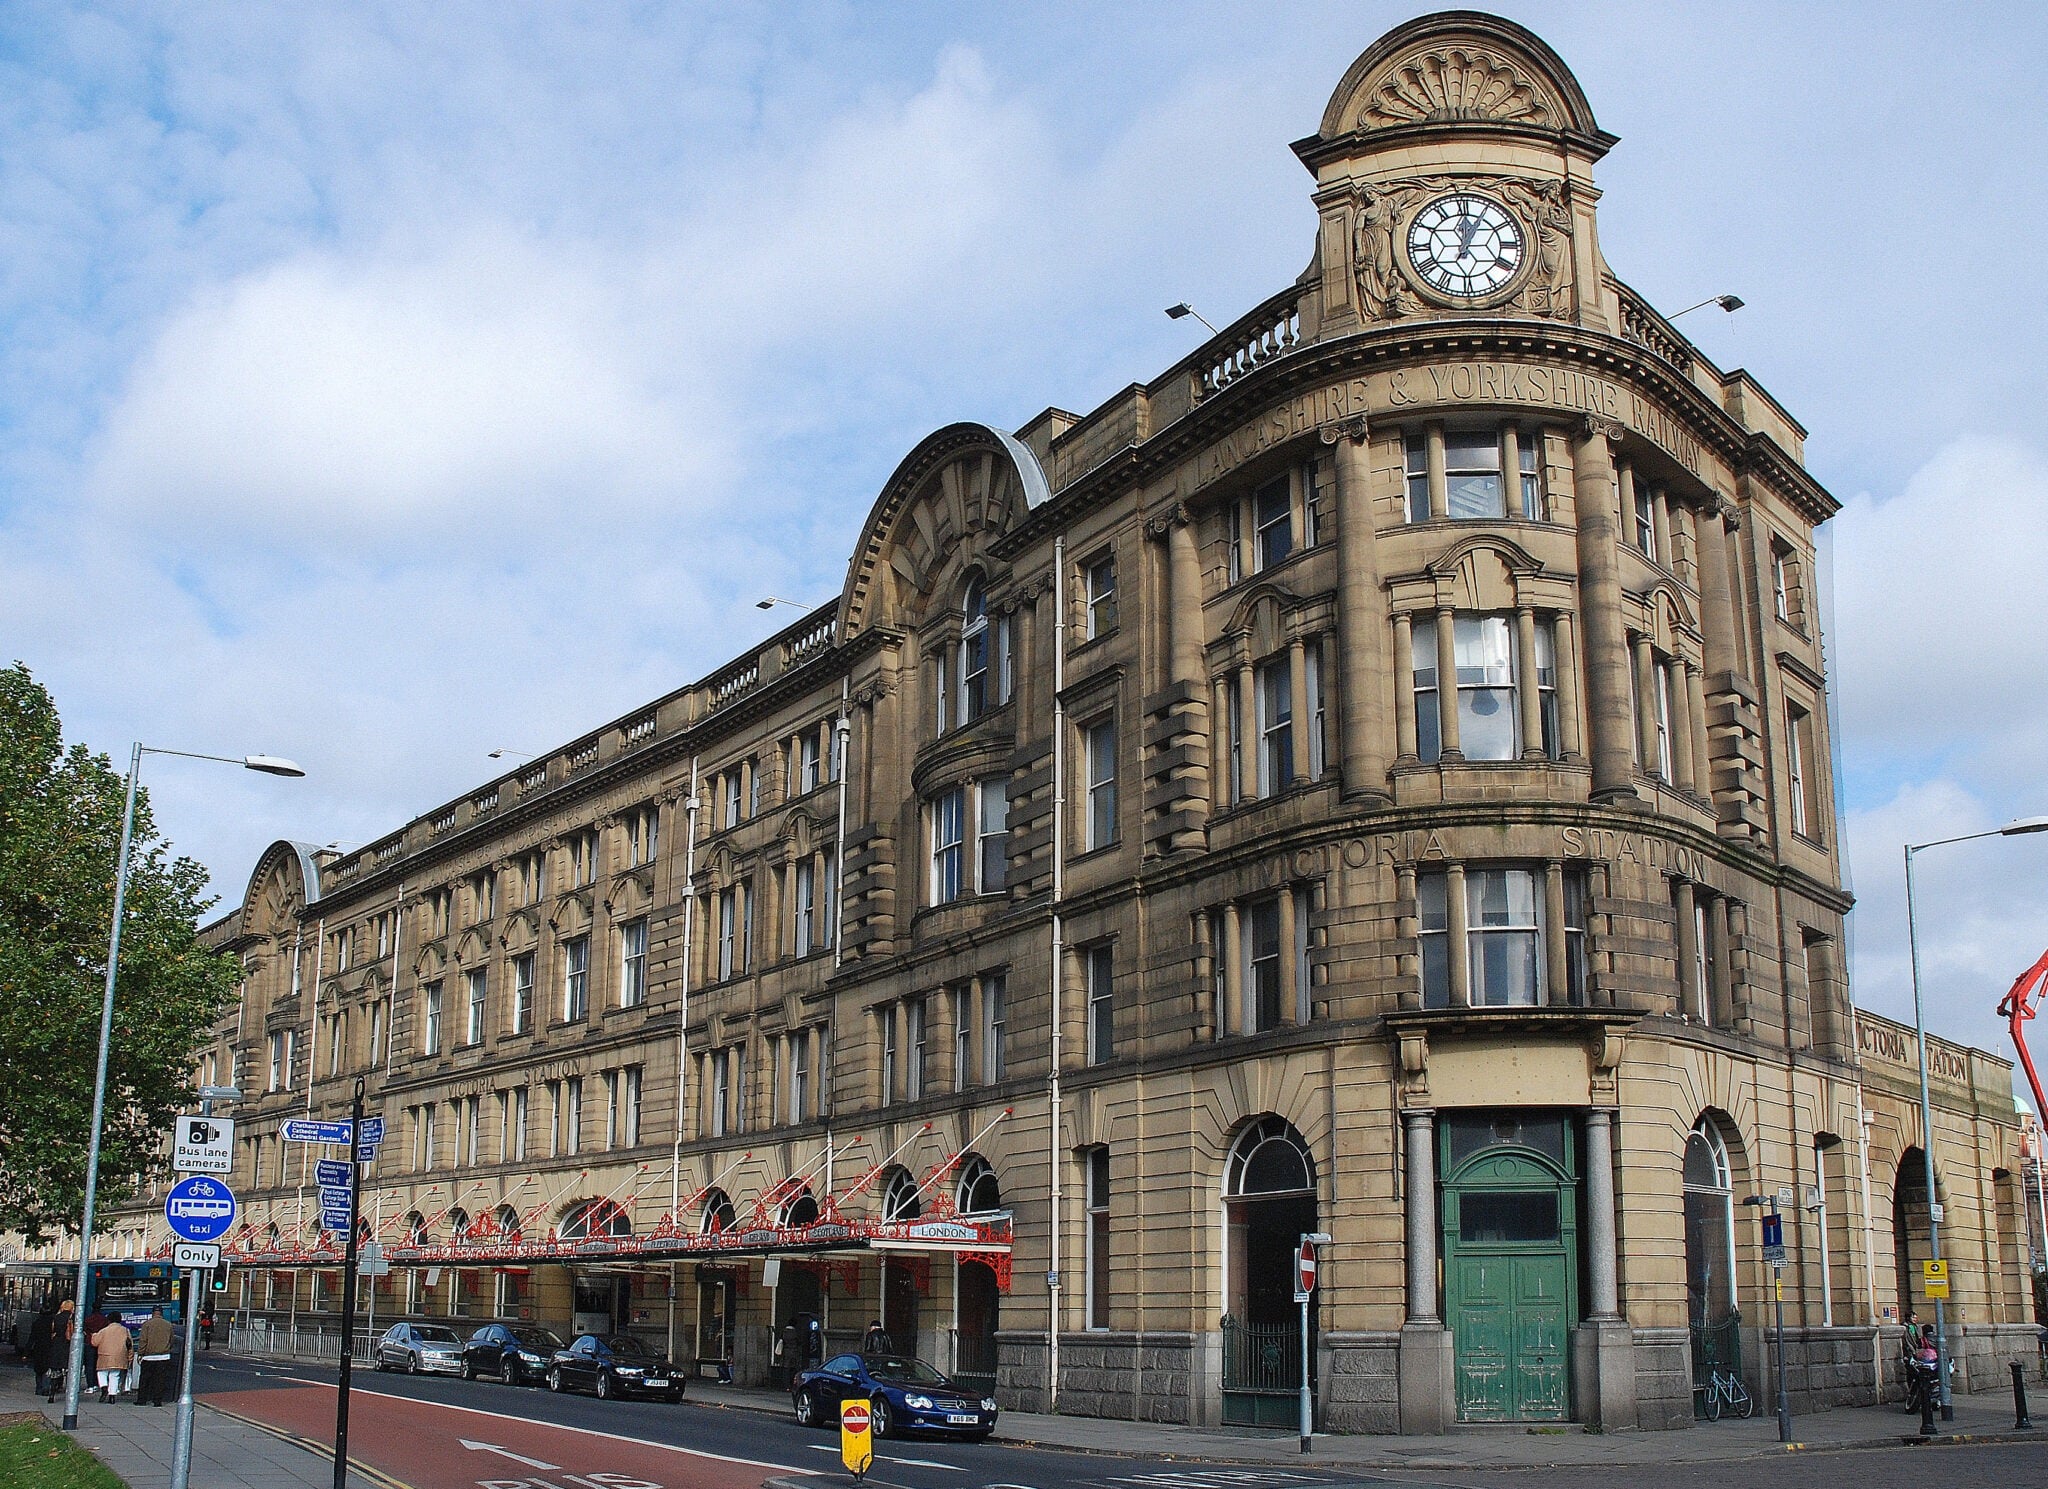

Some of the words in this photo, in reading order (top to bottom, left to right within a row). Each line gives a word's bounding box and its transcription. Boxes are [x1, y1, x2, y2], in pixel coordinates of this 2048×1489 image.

[1195, 378, 1369, 490] LANCASHIRE
[1389, 370, 1419, 405] &
[1427, 362, 1618, 420] YORKSHIRE
[1630, 393, 1702, 477] RAILWAY
[1257, 828, 1451, 885] VICTORIA
[1562, 826, 1705, 883] STATION
[1856, 1019, 1908, 1063] ICTORIA
[1926, 1044, 1966, 1080] TATION
[448, 1076, 497, 1098] VICTORIA
[524, 1060, 581, 1085] STATION
[320, 1124, 340, 1132] Library
[178, 1146, 200, 1156] Bus
[204, 1147, 228, 1158] lane
[178, 1159, 227, 1169] cameras
[189, 1224, 211, 1234] taxi
[813, 1227, 844, 1238] SCOTLAND
[921, 1226, 967, 1239] LONDON
[180, 1249, 214, 1264] Only
[812, 1321, 818, 1331] P
